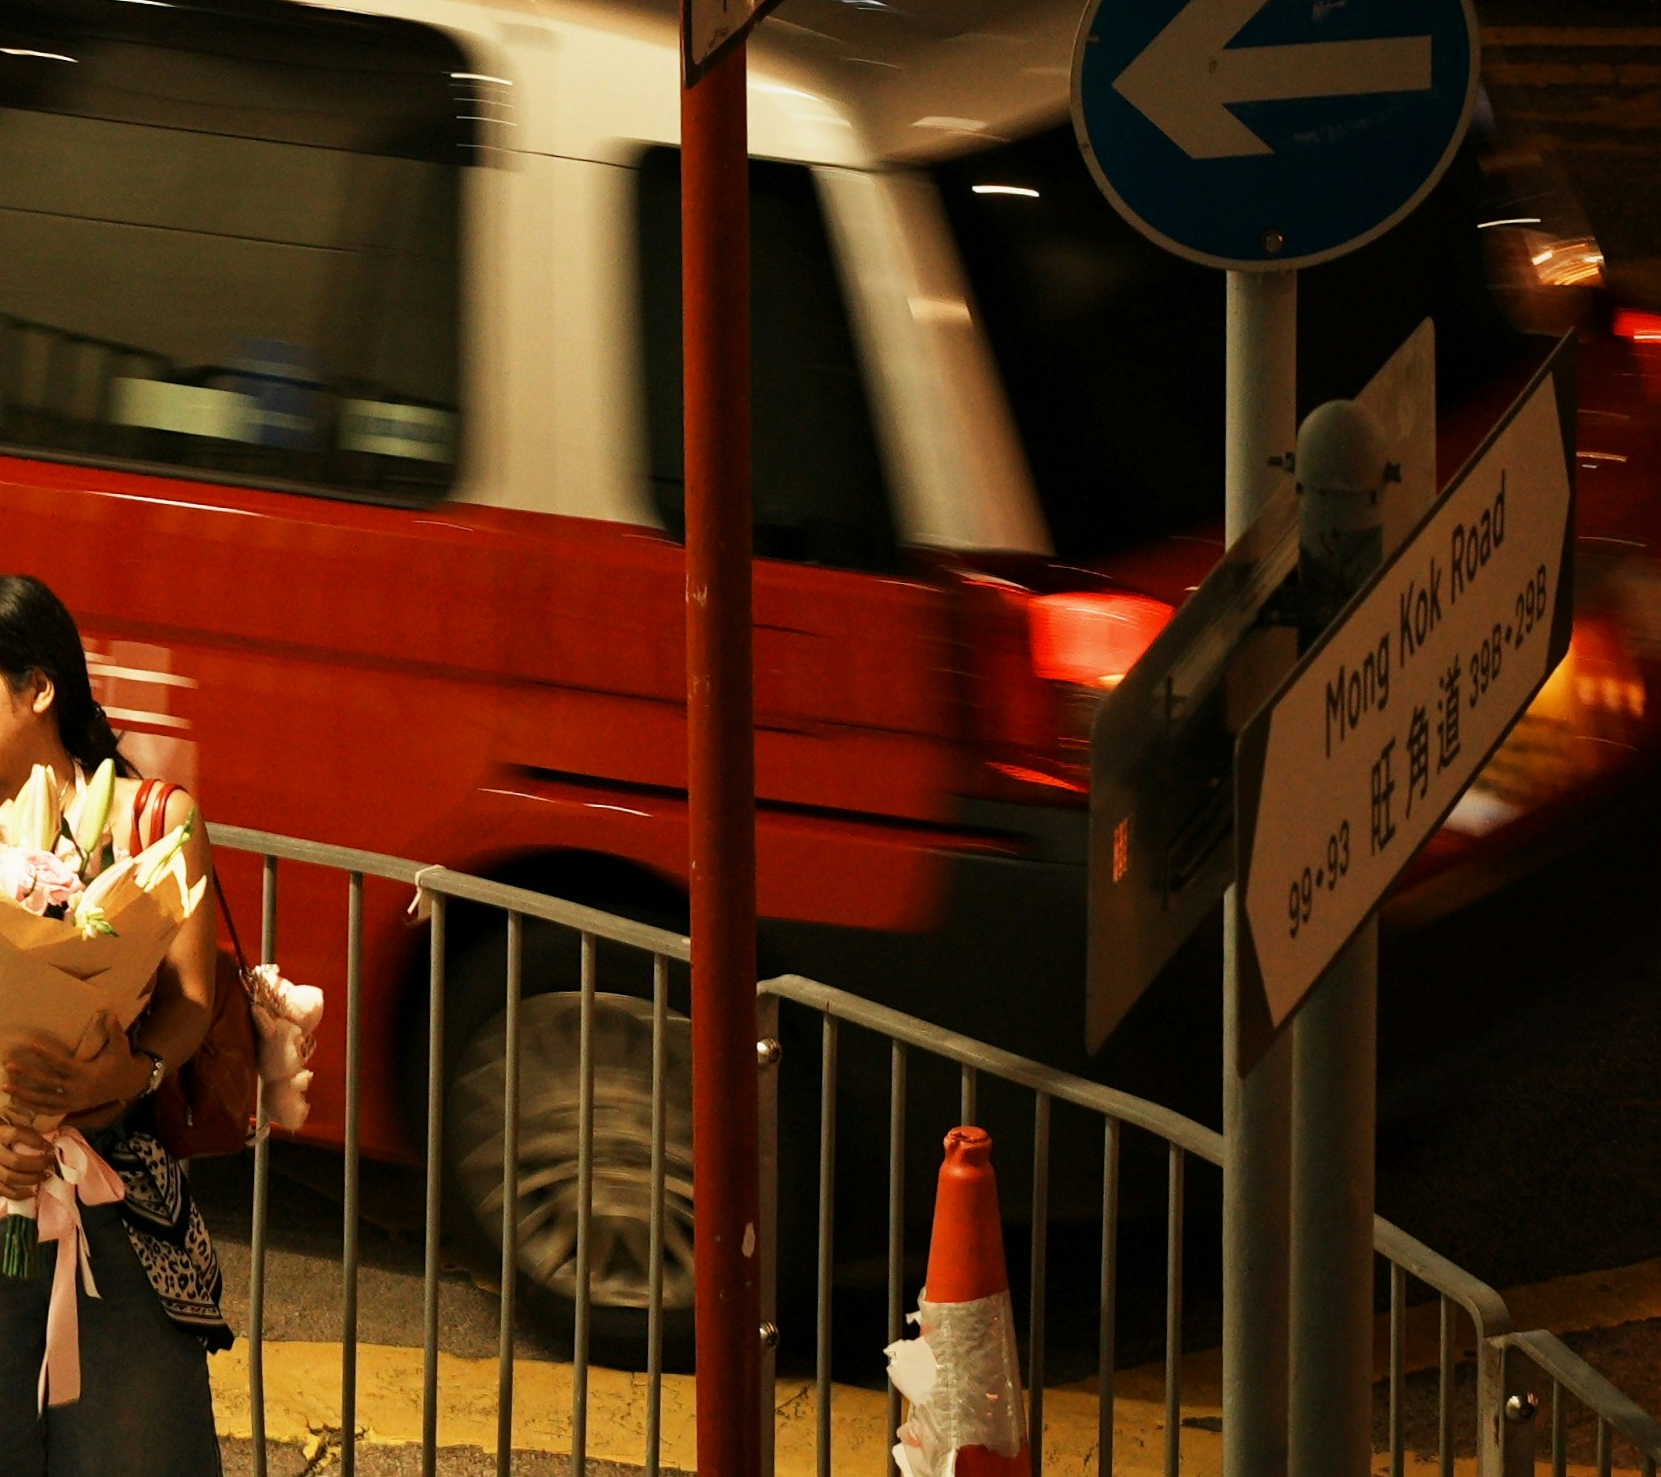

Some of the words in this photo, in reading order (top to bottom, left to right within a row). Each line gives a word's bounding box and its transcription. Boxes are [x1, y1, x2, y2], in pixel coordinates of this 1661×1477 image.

[1325, 631, 1390, 759] Mong
[1399, 557, 1443, 667] Kok
[1450, 468, 1507, 607] Road
[1370, 653, 1463, 857] 旺角道
